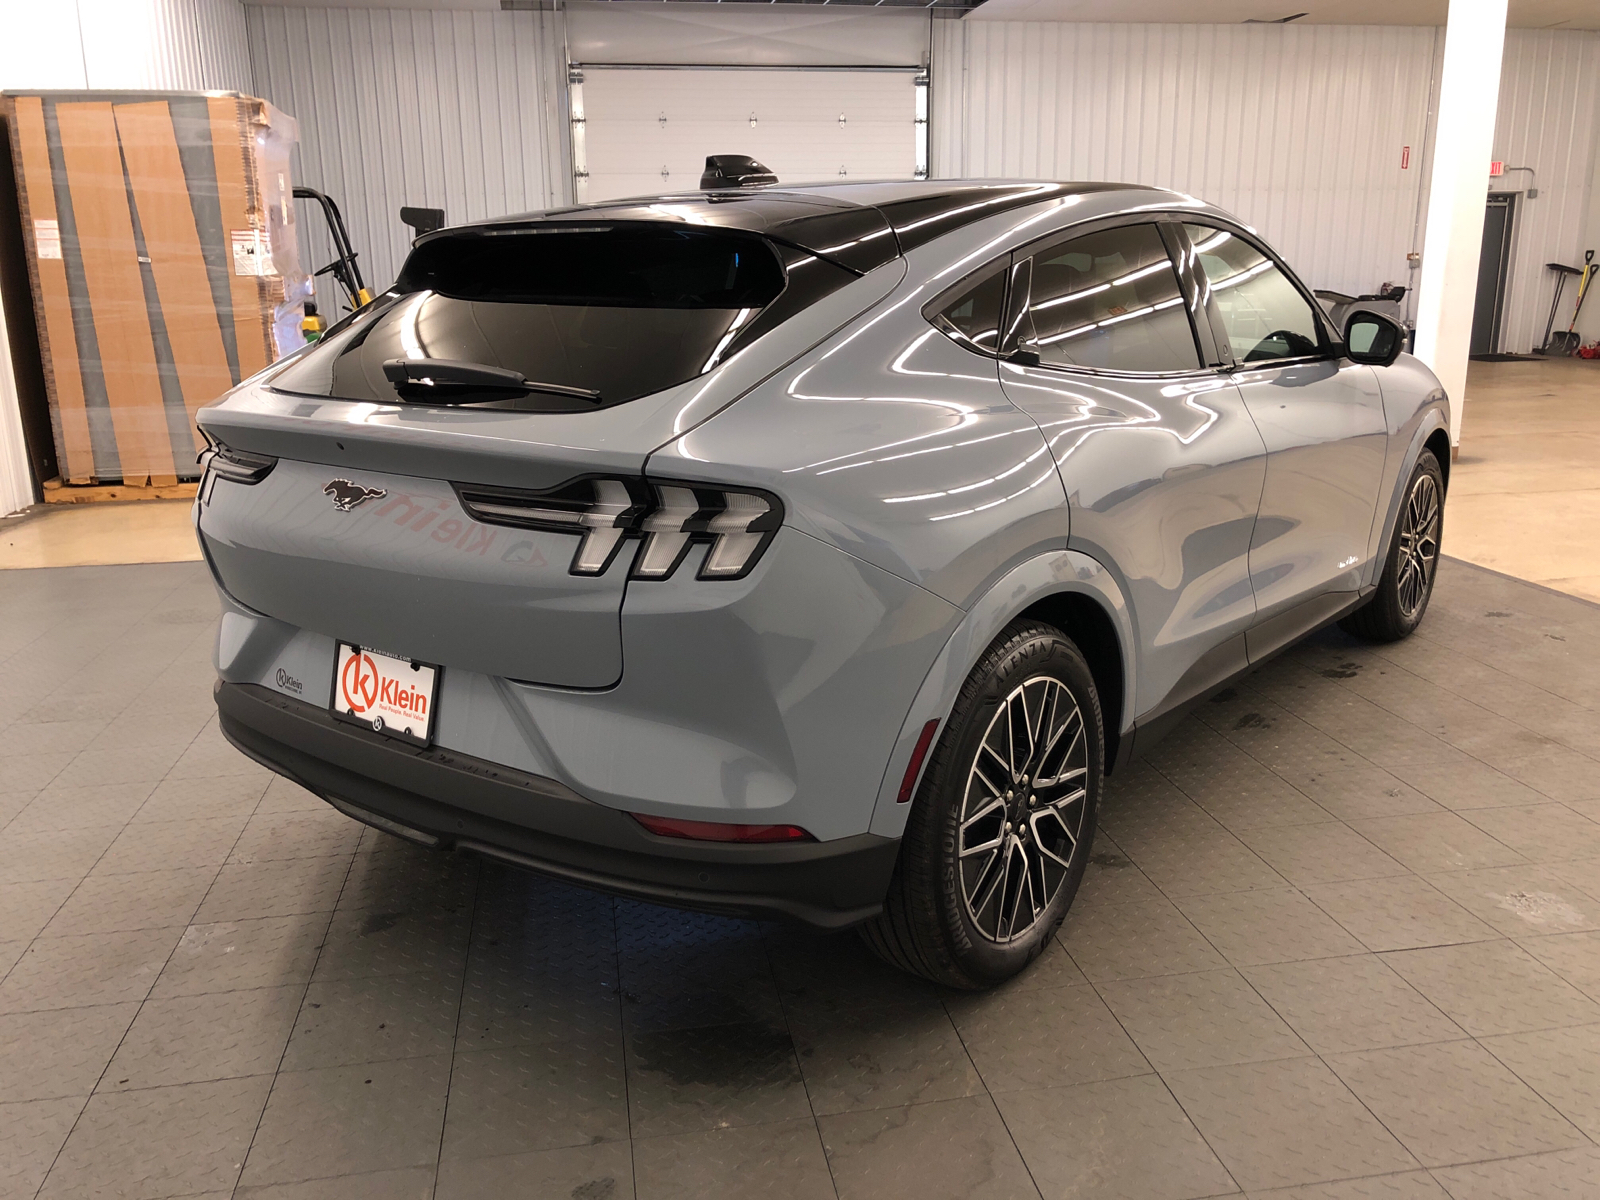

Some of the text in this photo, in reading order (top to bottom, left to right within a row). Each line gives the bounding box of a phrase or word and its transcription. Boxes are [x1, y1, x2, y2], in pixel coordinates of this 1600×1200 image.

[1491, 162, 1502, 175] XIT
[360, 645, 412, 662] www.kleinauto.com
[287, 675, 303, 690] Klein
[380, 676, 427, 714] Klein
[942, 804, 972, 955] BRIDGESTONE
